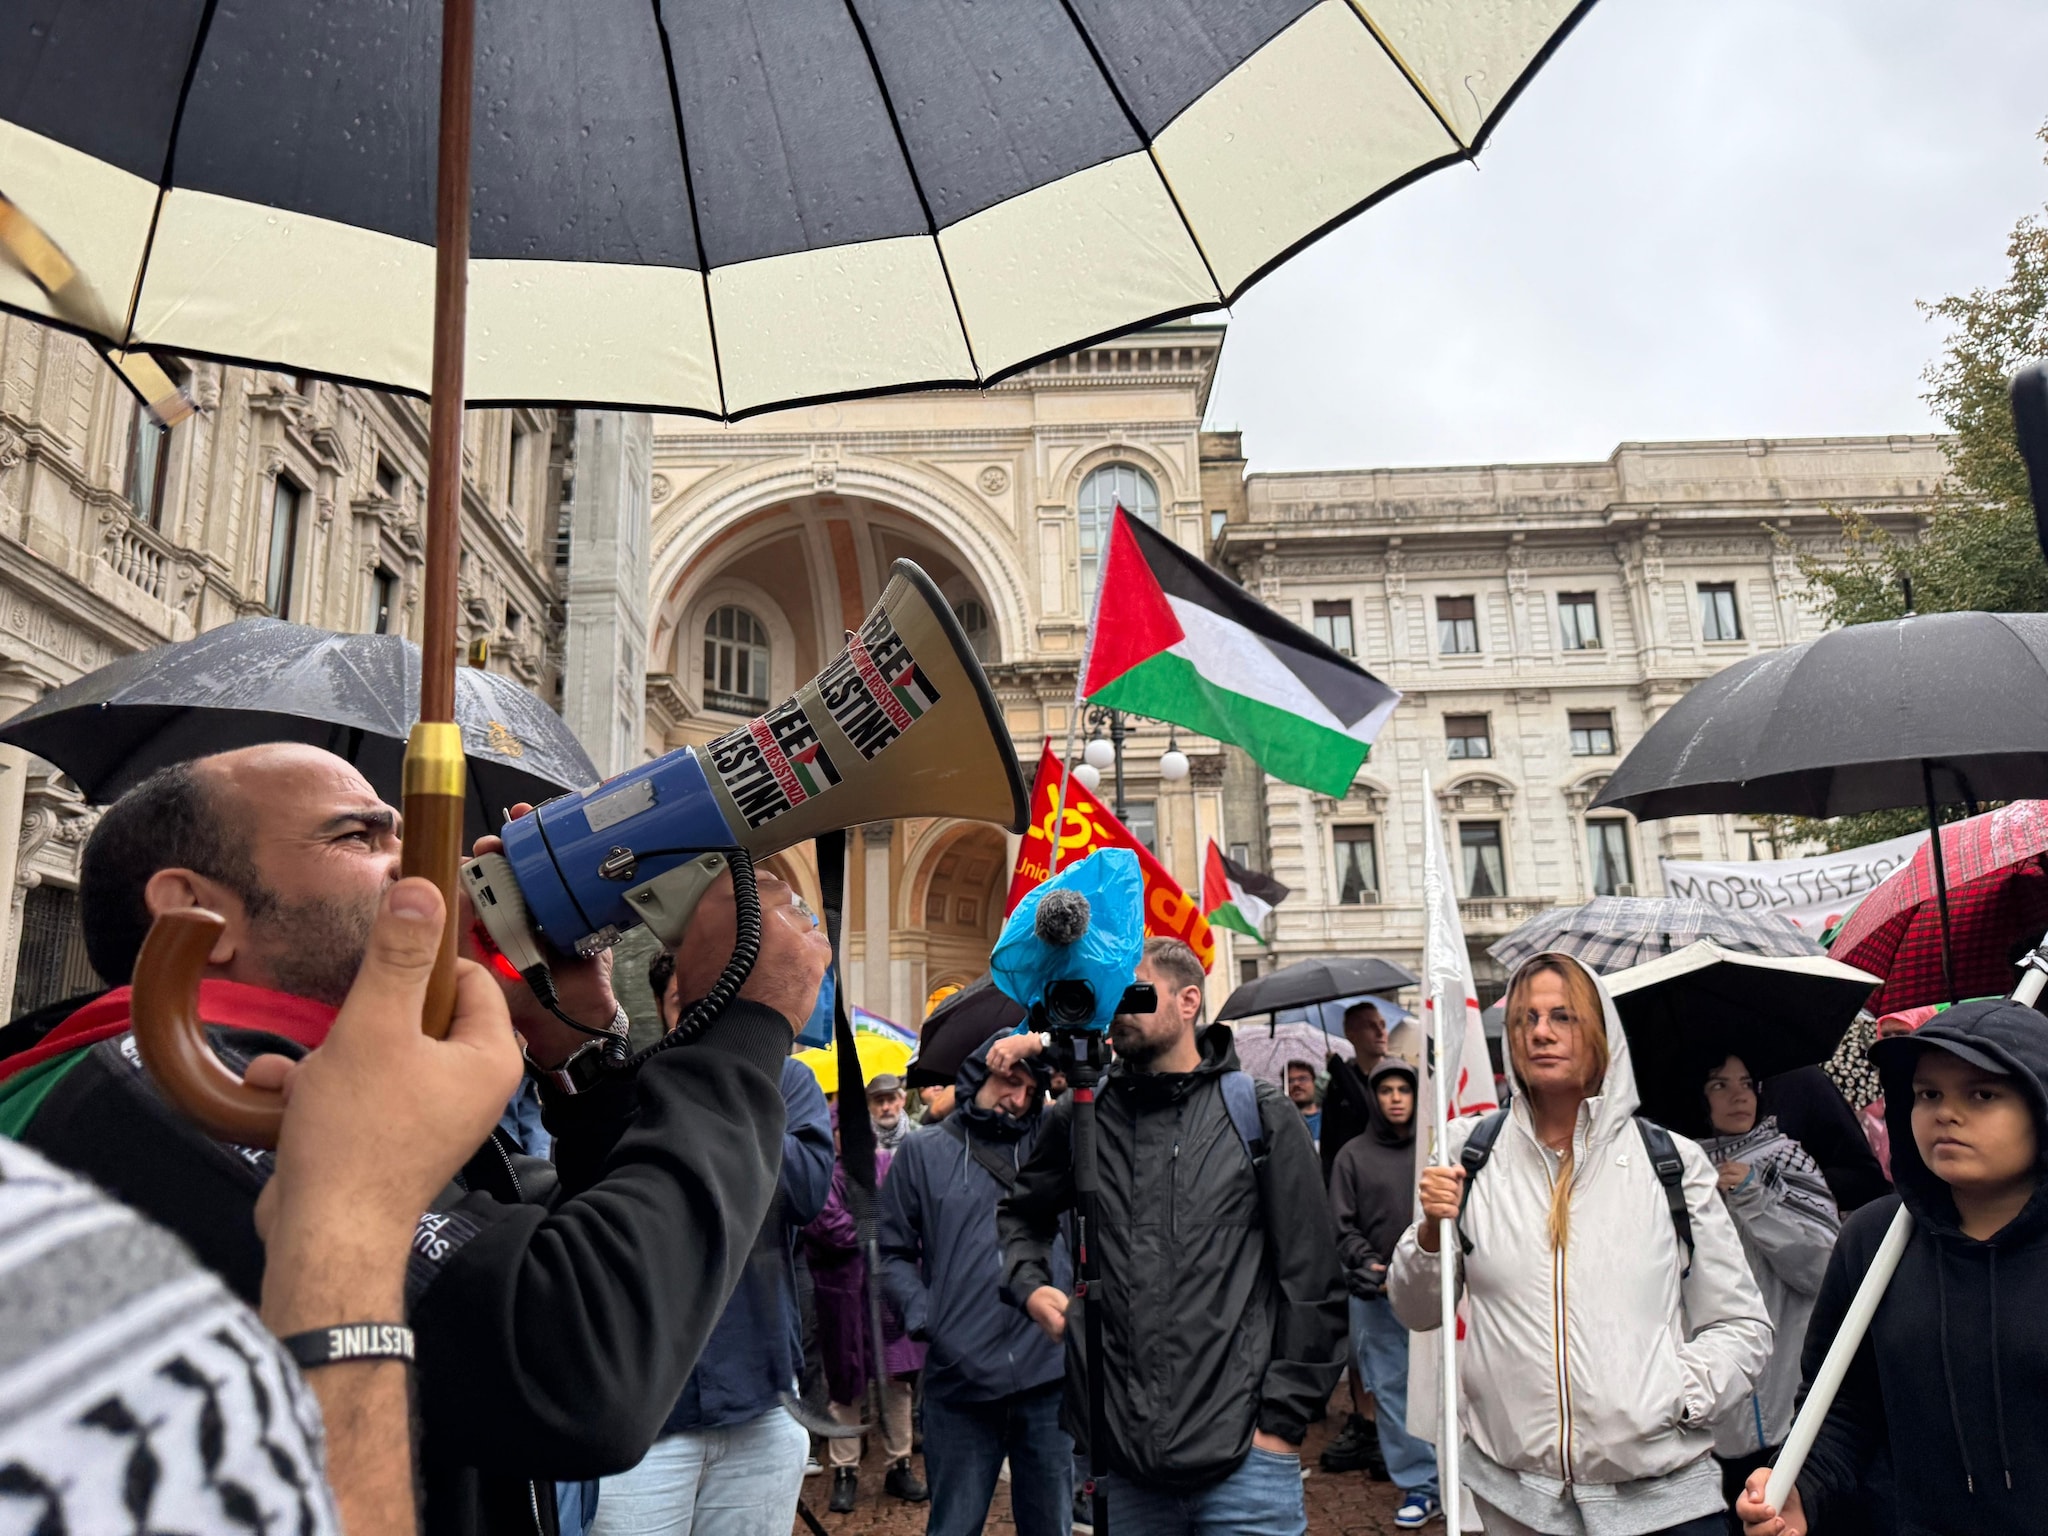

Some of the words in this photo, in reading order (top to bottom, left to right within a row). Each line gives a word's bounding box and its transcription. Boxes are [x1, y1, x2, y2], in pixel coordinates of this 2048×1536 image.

[860, 607, 914, 682] FREE
[763, 696, 819, 758] REE
[817, 650, 900, 761] ALESTINE
[866, 673, 913, 732] RESISTENZA
[763, 746, 808, 807] RESISTENZA
[1670, 854, 1905, 909] MOBILITAZIO
